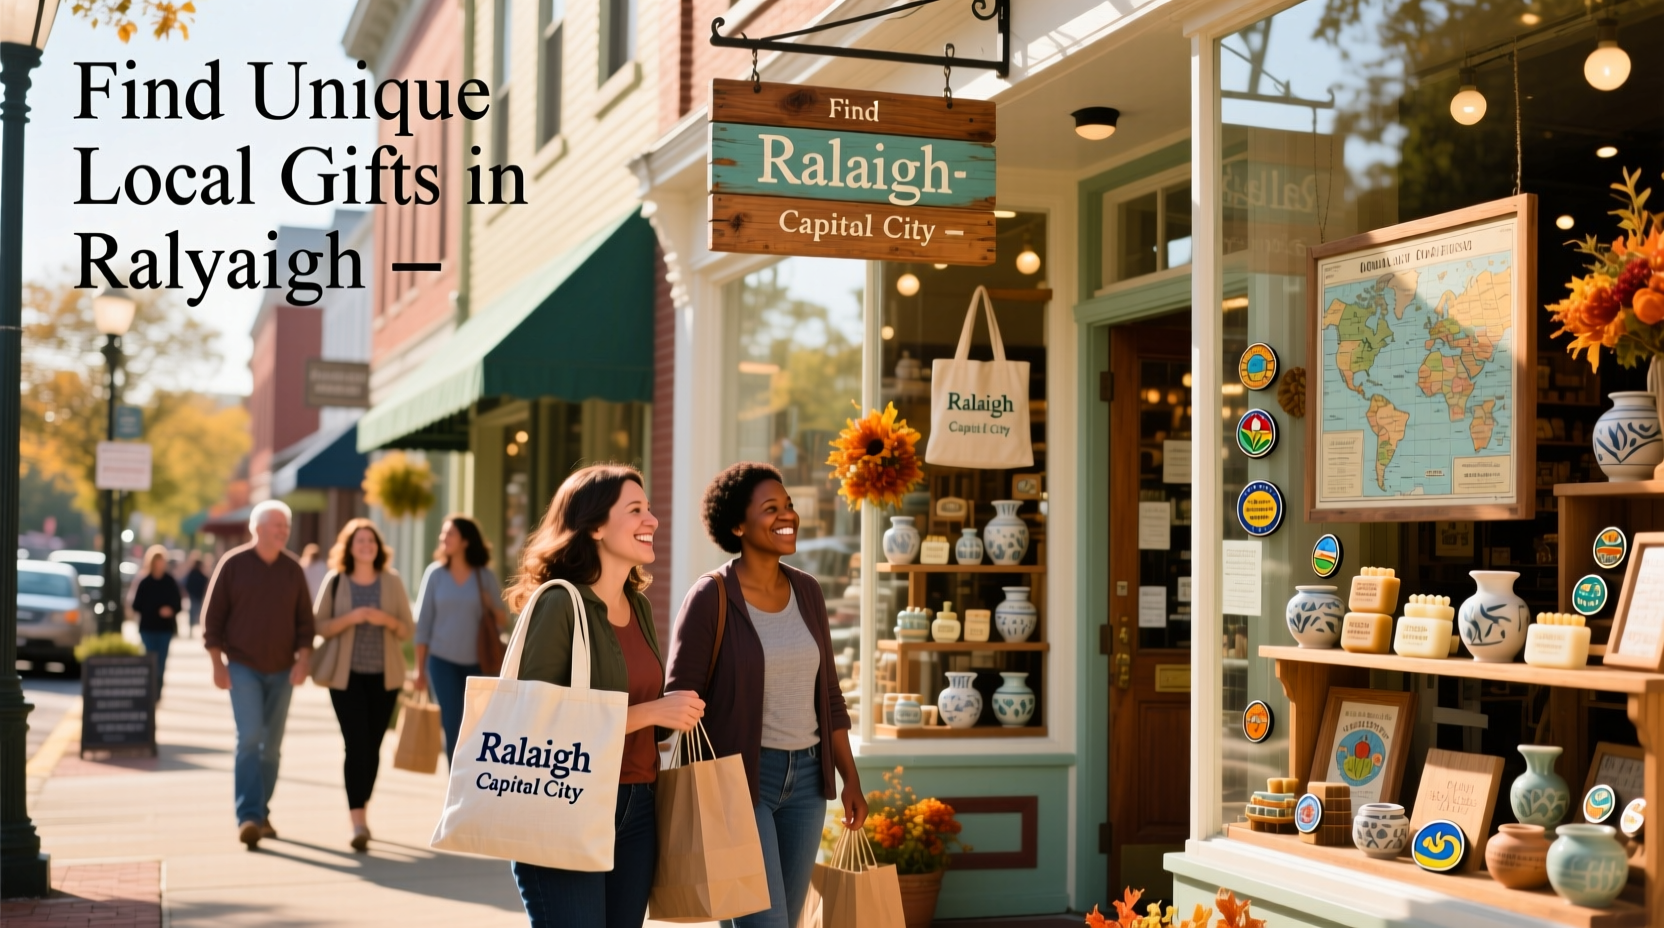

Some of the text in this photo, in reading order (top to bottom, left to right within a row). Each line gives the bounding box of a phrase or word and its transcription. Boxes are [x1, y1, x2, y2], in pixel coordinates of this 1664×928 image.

[829, 98, 878, 122] Find
[757, 133, 967, 206] Ralaigh-
[779, 209, 873, 242] Capital
[883, 215, 936, 247] City
[947, 392, 1015, 418] Ralaigh
[475, 732, 592, 780] Ralaigh
[476, 772, 585, 805] Capital City
